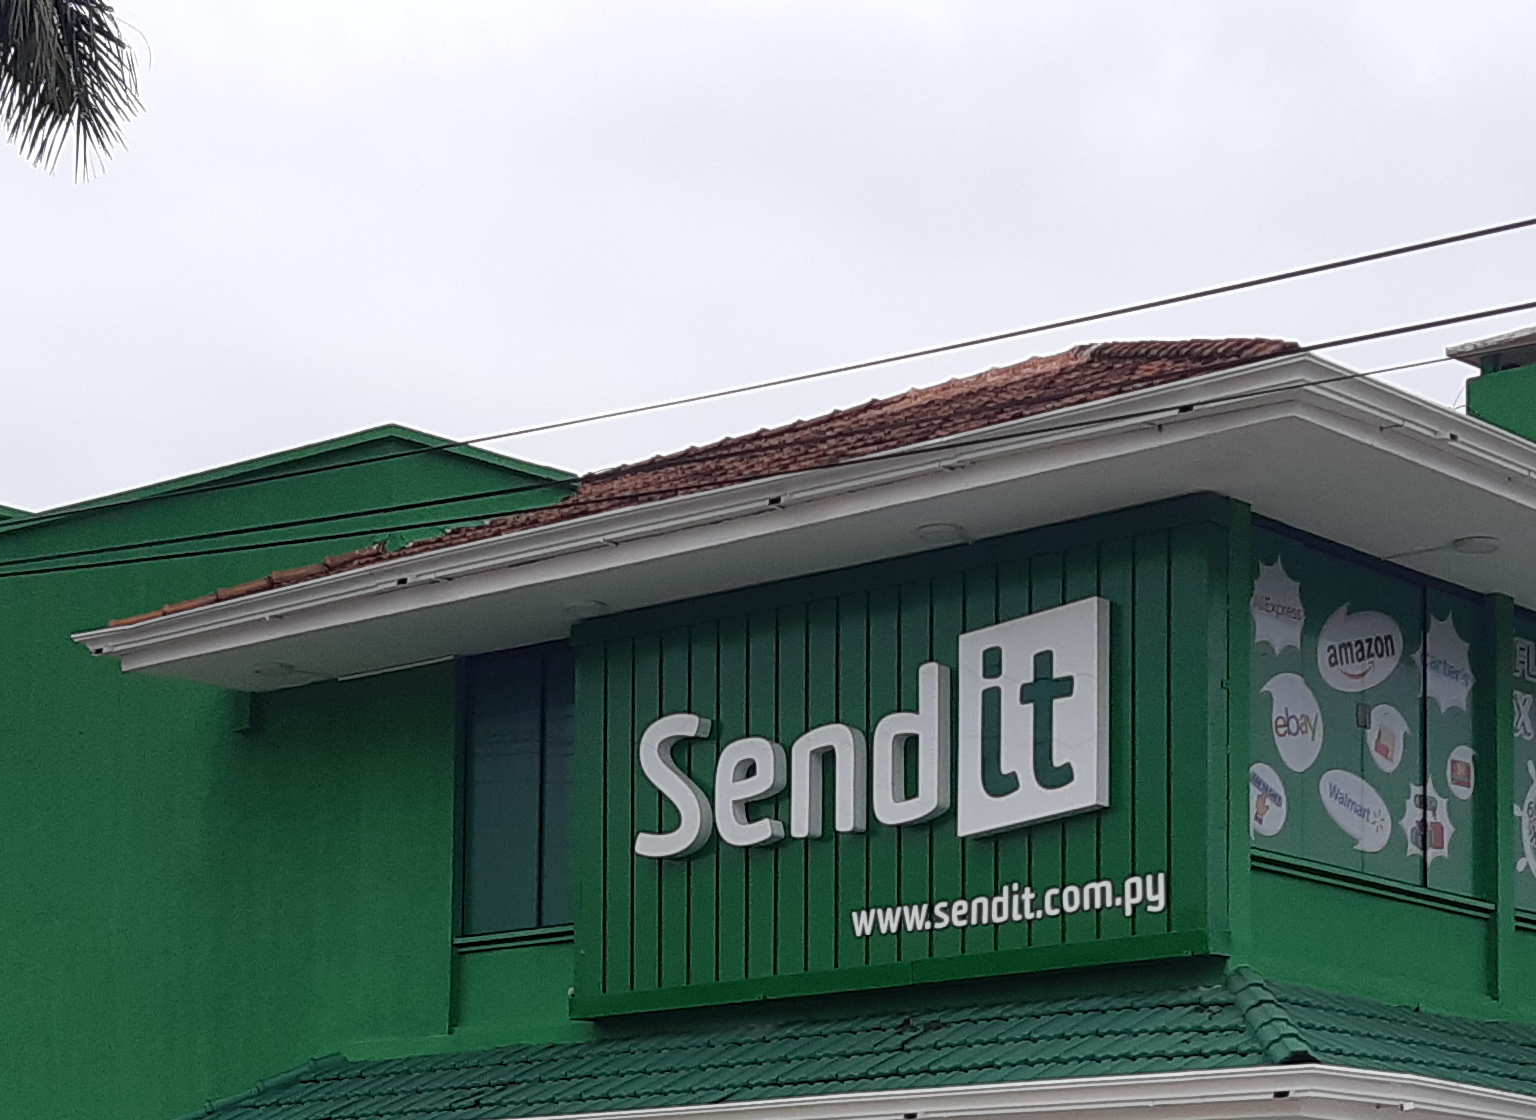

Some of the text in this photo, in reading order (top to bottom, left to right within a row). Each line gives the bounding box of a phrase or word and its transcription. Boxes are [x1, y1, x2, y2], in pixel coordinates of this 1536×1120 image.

[1327, 633, 1396, 668] amazon
[1274, 706, 1319, 742] ebay
[635, 645, 1076, 860] Sendit
[1328, 782, 1371, 823] Walmart
[851, 872, 1166, 937] www.sendit.com.py
